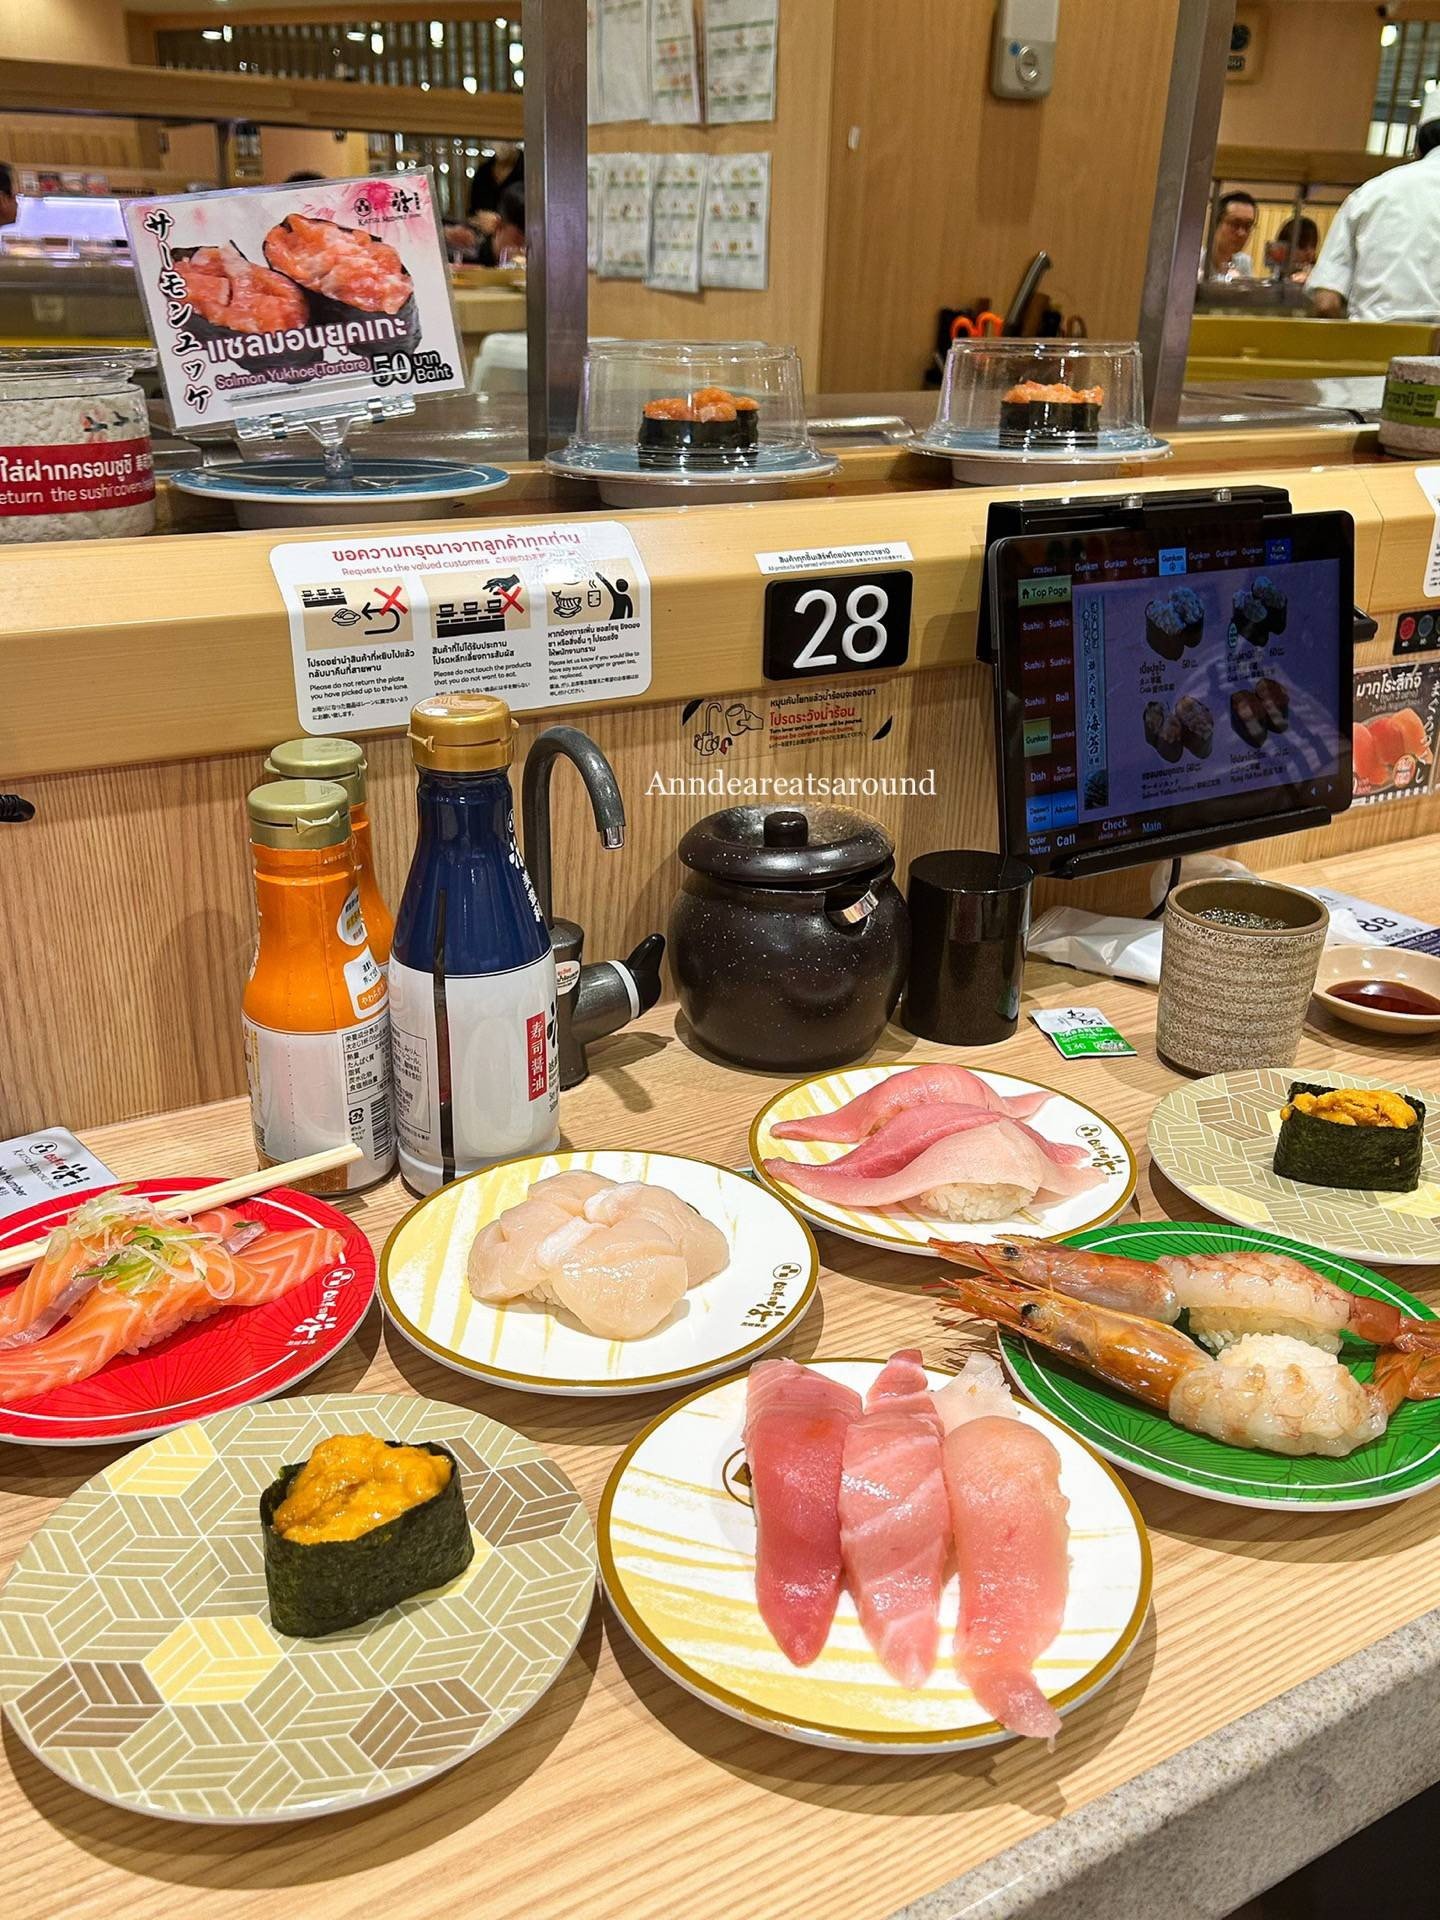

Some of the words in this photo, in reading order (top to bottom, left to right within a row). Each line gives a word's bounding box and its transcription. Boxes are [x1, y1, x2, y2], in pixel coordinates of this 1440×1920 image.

[144, 210, 213, 413] サーモンユッケ
[413, 352, 439, 368] บาท
[215, 372, 268, 390] Salmon
[373, 352, 411, 386] 50
[415, 365, 451, 382] Baht
[51, 486, 77, 502] the
[79, 483, 114, 500] sushi
[332, 532, 581, 562] ขอความกรุณาจากลูกค้าทุกท่าน
[342, 565, 379, 577] Request
[381, 565, 392, 573] to
[394, 562, 409, 572] the
[411, 560, 442, 571] valued
[443, 557, 490, 569] customers
[1031, 587, 1047, 599] Top
[1048, 586, 1068, 597] Page
[793, 584, 890, 669] 28
[433, 669, 454, 677] Please
[476, 665, 493, 673] touch
[505, 661, 532, 671] products
[310, 683, 332, 691] Please
[333, 681, 342, 689] do
[342, 680, 354, 688] not
[355, 678, 375, 687] return
[376, 676, 387, 684] the
[388, 675, 405, 684] plate
[434, 678, 448, 686] that
[481, 673, 497, 681] want
[324, 690, 340, 699] have
[341, 688, 363, 697] picked
[364, 687, 373, 695] up
[382, 684, 393, 692] the
[1056, 692, 1070, 702] Roll
[770, 703, 855, 727] โปรดระวังน้ำร้อน
[1025, 735, 1049, 744] Gunkan
[1030, 772, 1047, 783] Dish
[1102, 819, 1128, 831] Check
[1142, 821, 1162, 833] Main
[1056, 833, 1076, 847] Call
[347, 1053, 375, 1069] たんぱく質
[530, 1020, 545, 1094] 寿司醤油
